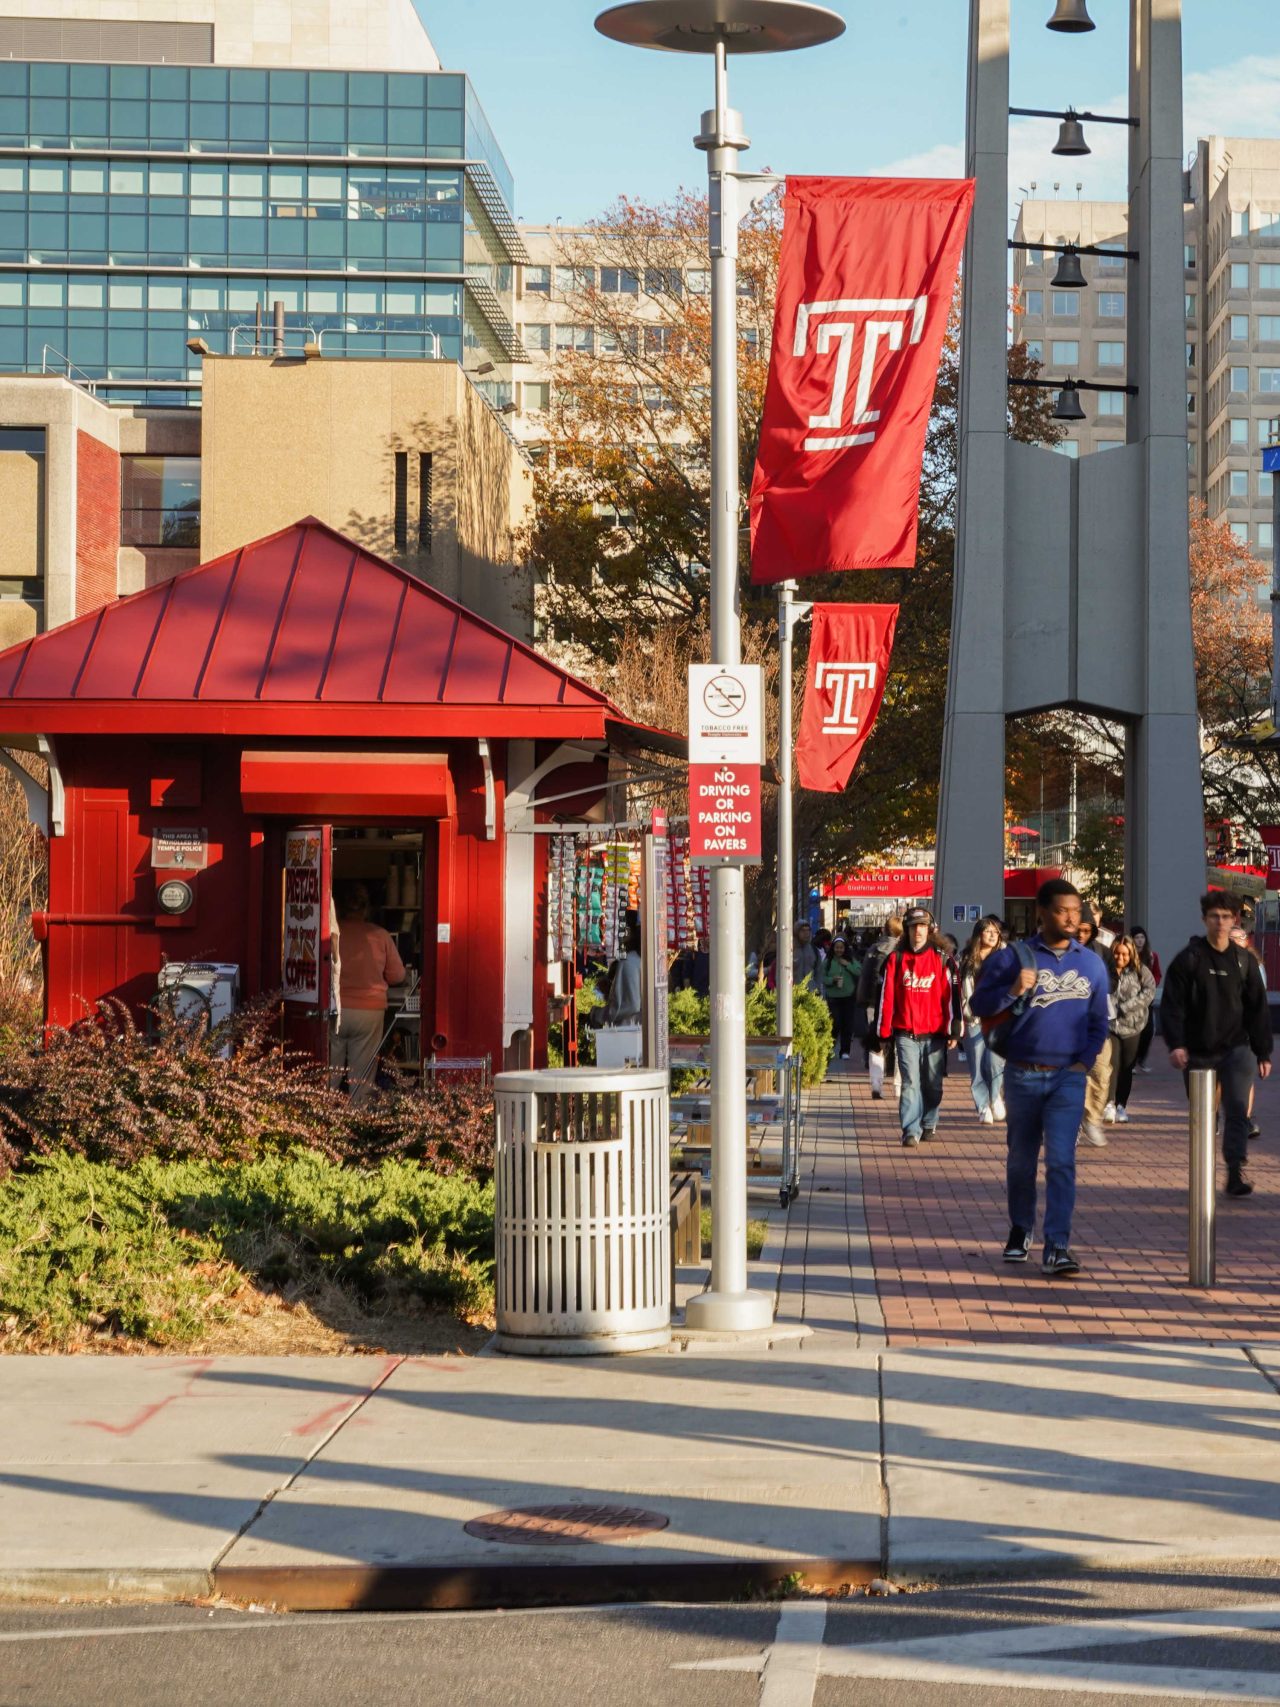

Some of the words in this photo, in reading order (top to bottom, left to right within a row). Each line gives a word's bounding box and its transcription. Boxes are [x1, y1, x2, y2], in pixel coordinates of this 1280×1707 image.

[794, 296, 927, 451] T
[814, 661, 876, 735] T
[714, 771, 736, 783] NO
[699, 784, 751, 797] DRIVING
[715, 798, 734, 810] OR
[698, 811, 752, 823] PARKING
[714, 825, 736, 837] ON
[704, 838, 747, 850] PAVERS
[893, 874, 905, 882] OF
[286, 958, 317, 991] COFFEE
[903, 969, 936, 989] Bud
[1033, 969, 1091, 997] Polo
